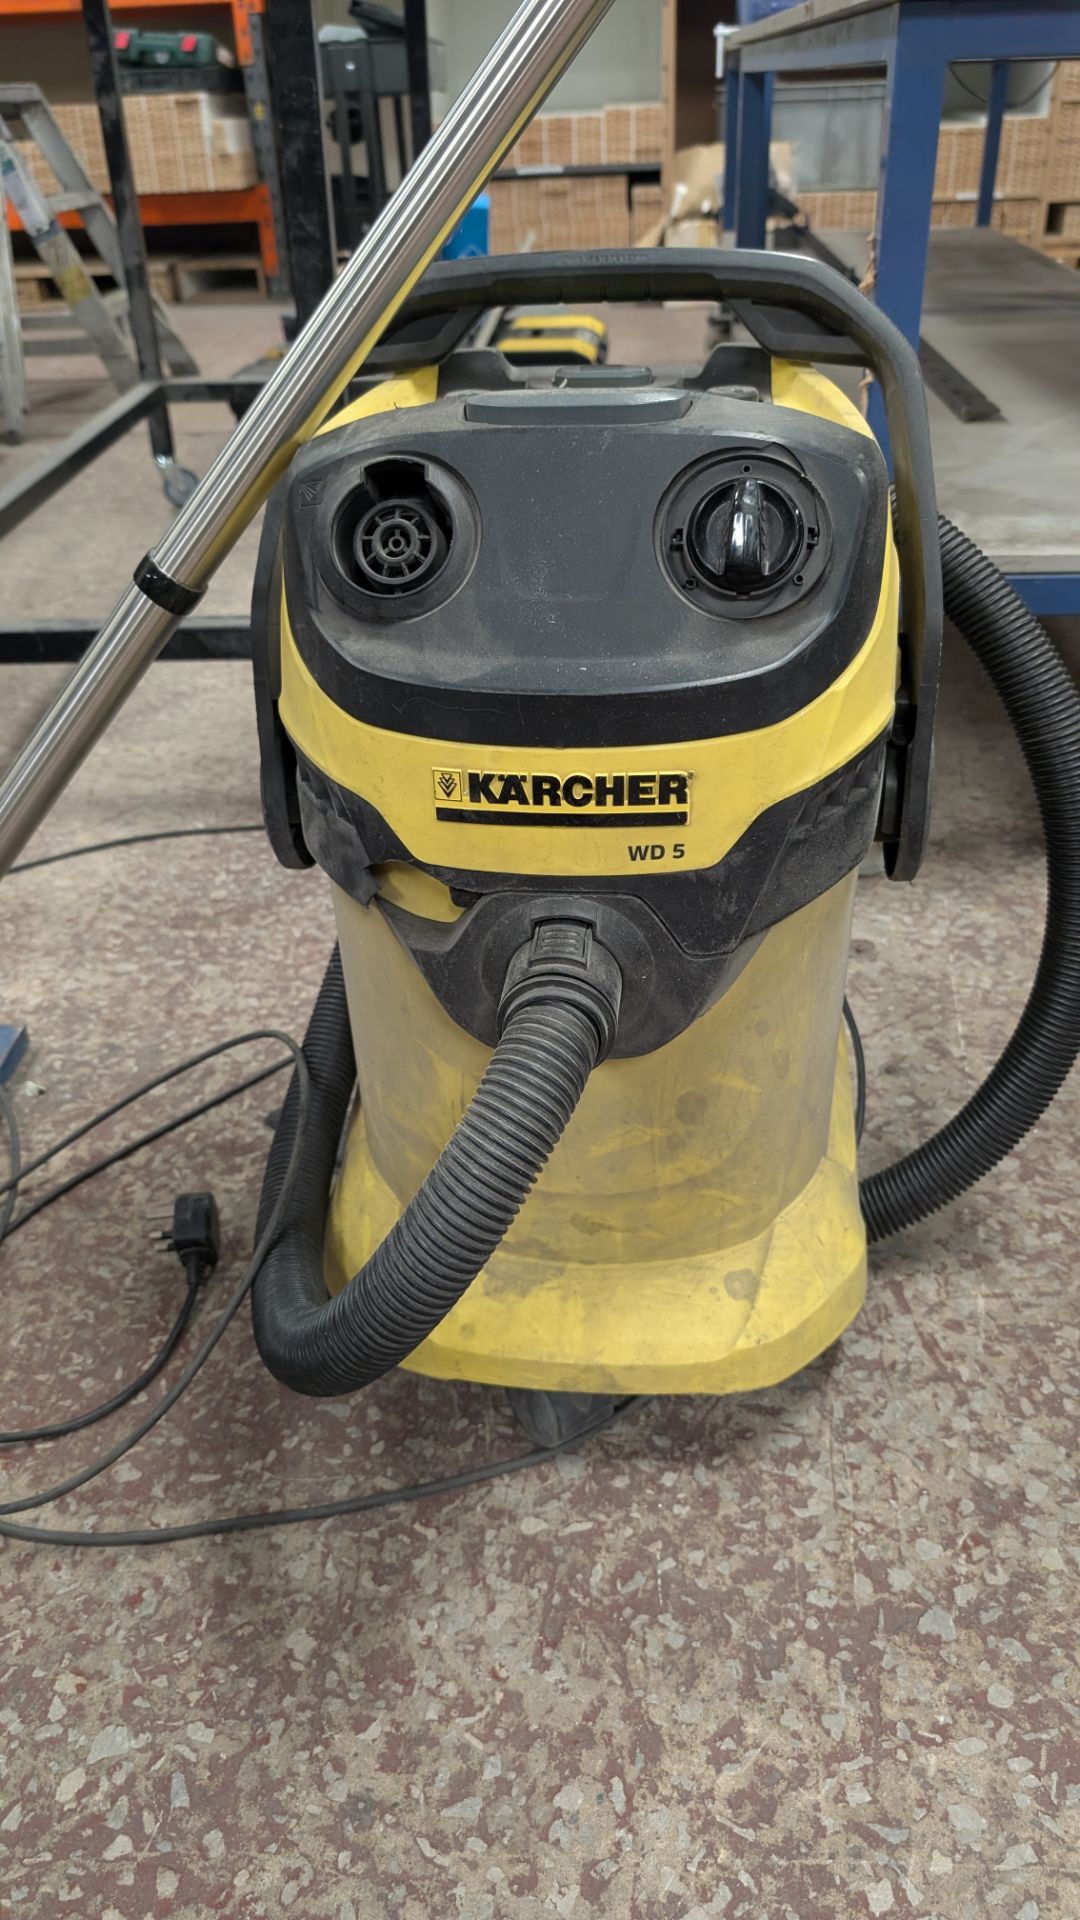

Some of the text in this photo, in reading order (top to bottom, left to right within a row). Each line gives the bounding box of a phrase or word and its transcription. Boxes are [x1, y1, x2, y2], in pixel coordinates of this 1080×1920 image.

[467, 772, 688, 807] KÄRCHER
[628, 843, 685, 861] WD 5
